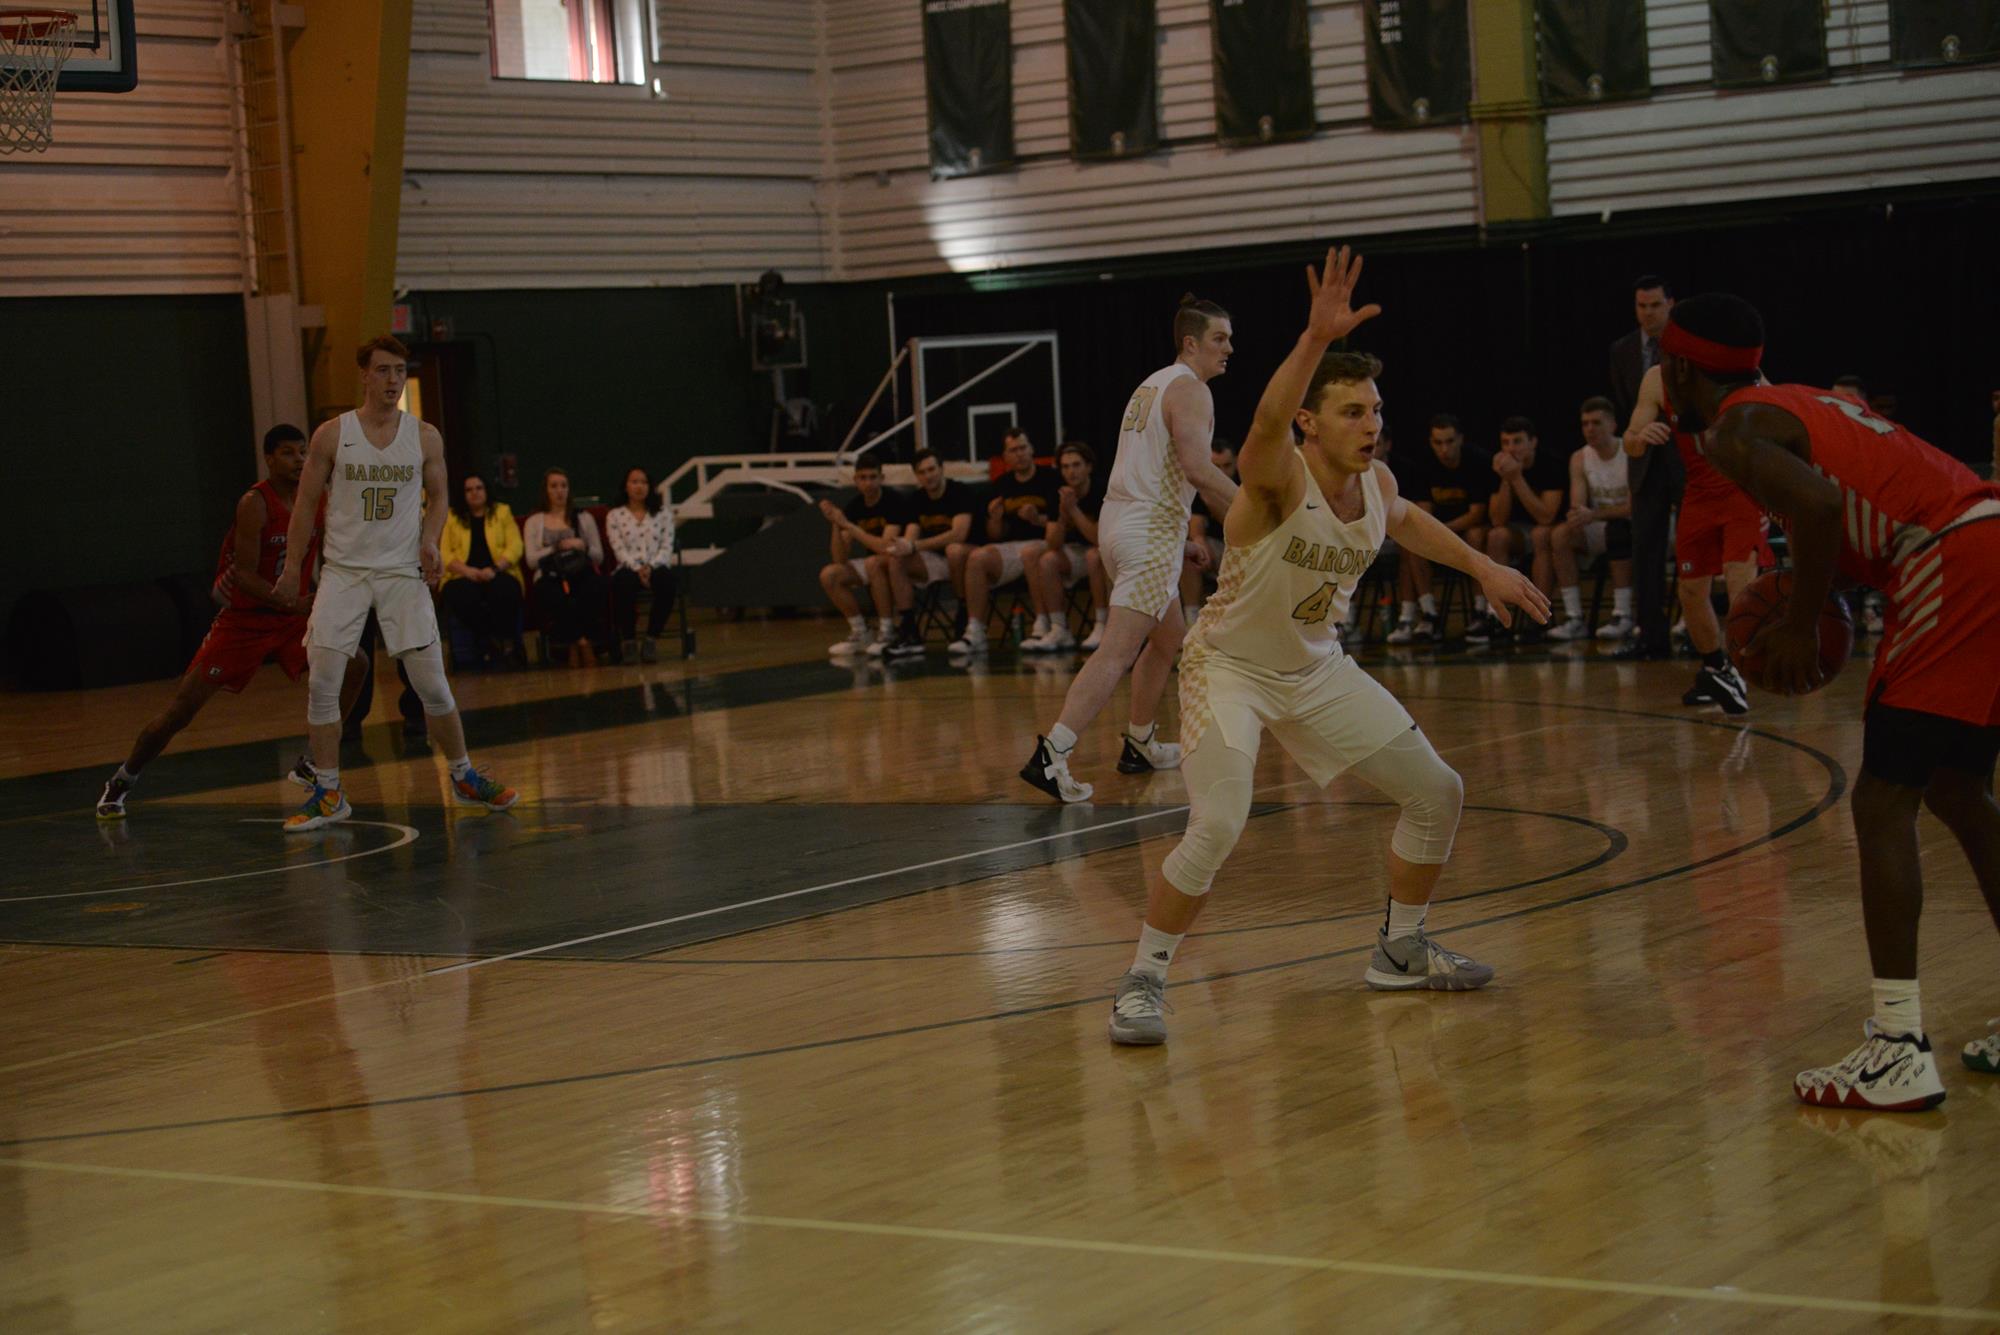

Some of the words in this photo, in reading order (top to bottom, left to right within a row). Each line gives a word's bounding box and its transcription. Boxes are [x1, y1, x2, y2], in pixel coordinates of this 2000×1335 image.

[345, 464, 414, 482] BARONS
[361, 487, 397, 521] 15
[1291, 582, 1338, 625] 4
